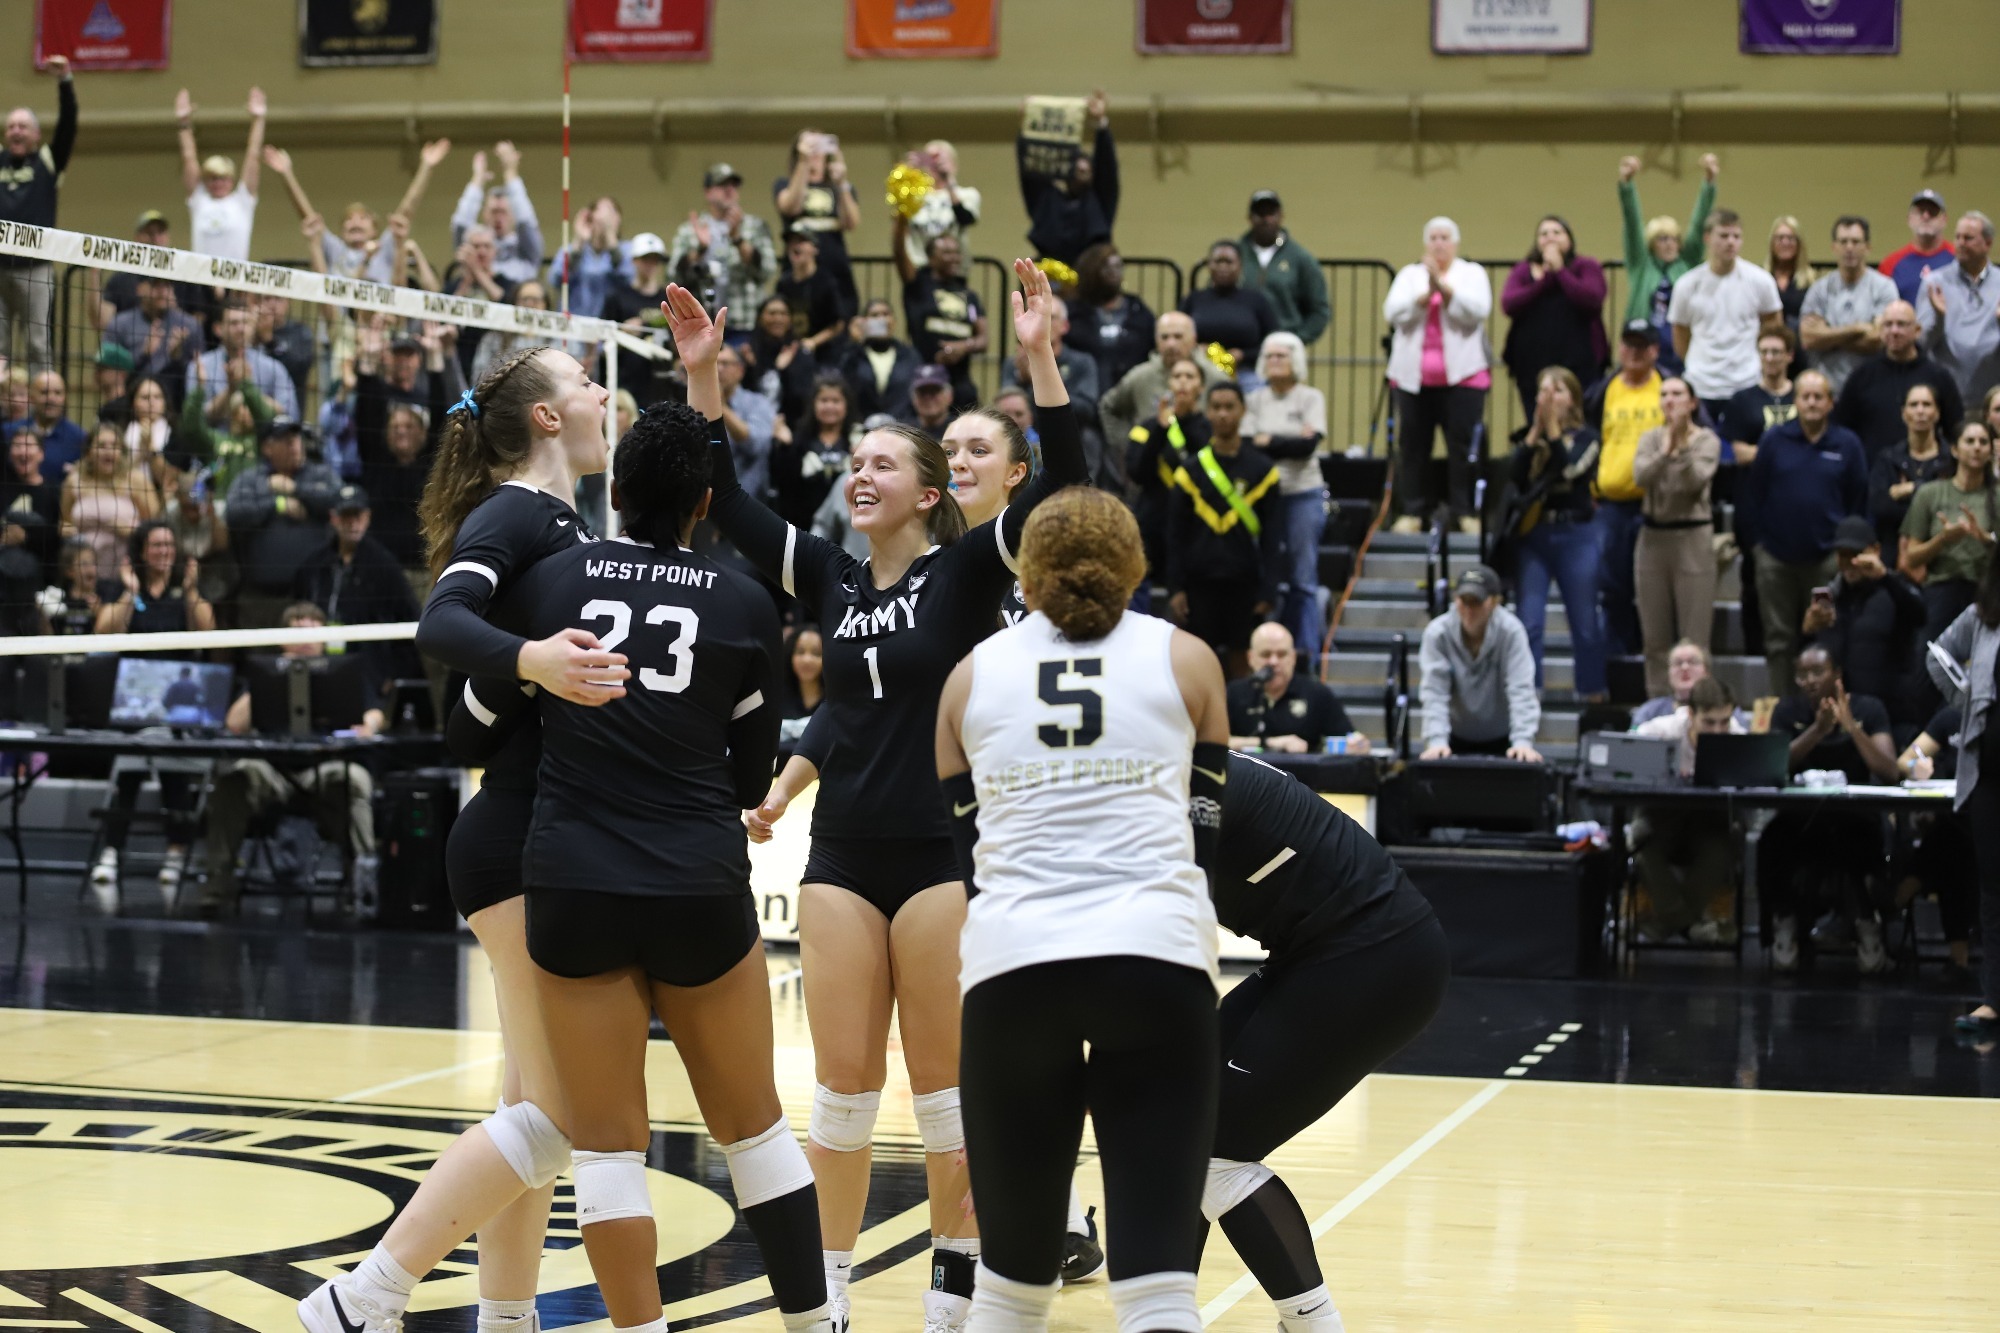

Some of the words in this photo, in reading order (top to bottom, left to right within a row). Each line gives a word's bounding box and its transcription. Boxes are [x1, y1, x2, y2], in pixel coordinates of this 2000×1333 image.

[13, 223, 44, 249] POINT
[93, 238, 120, 262] ARMY
[122, 243, 147, 266] WEST
[148, 247, 175, 271] POINT
[218, 258, 243, 281] ARMY
[244, 263, 267, 285] WEST
[268, 267, 292, 289] POINT
[331, 278, 352, 297] ARMY
[353, 281, 374, 302] WEST
[585, 559, 648, 581] WEST
[651, 564, 718, 589] POINT
[833, 592, 920, 639] ARMY
[580, 599, 700, 694] 23
[863, 646, 883, 699] 1
[1036, 656, 1105, 748] 5
[1073, 757, 1164, 789] POINT
